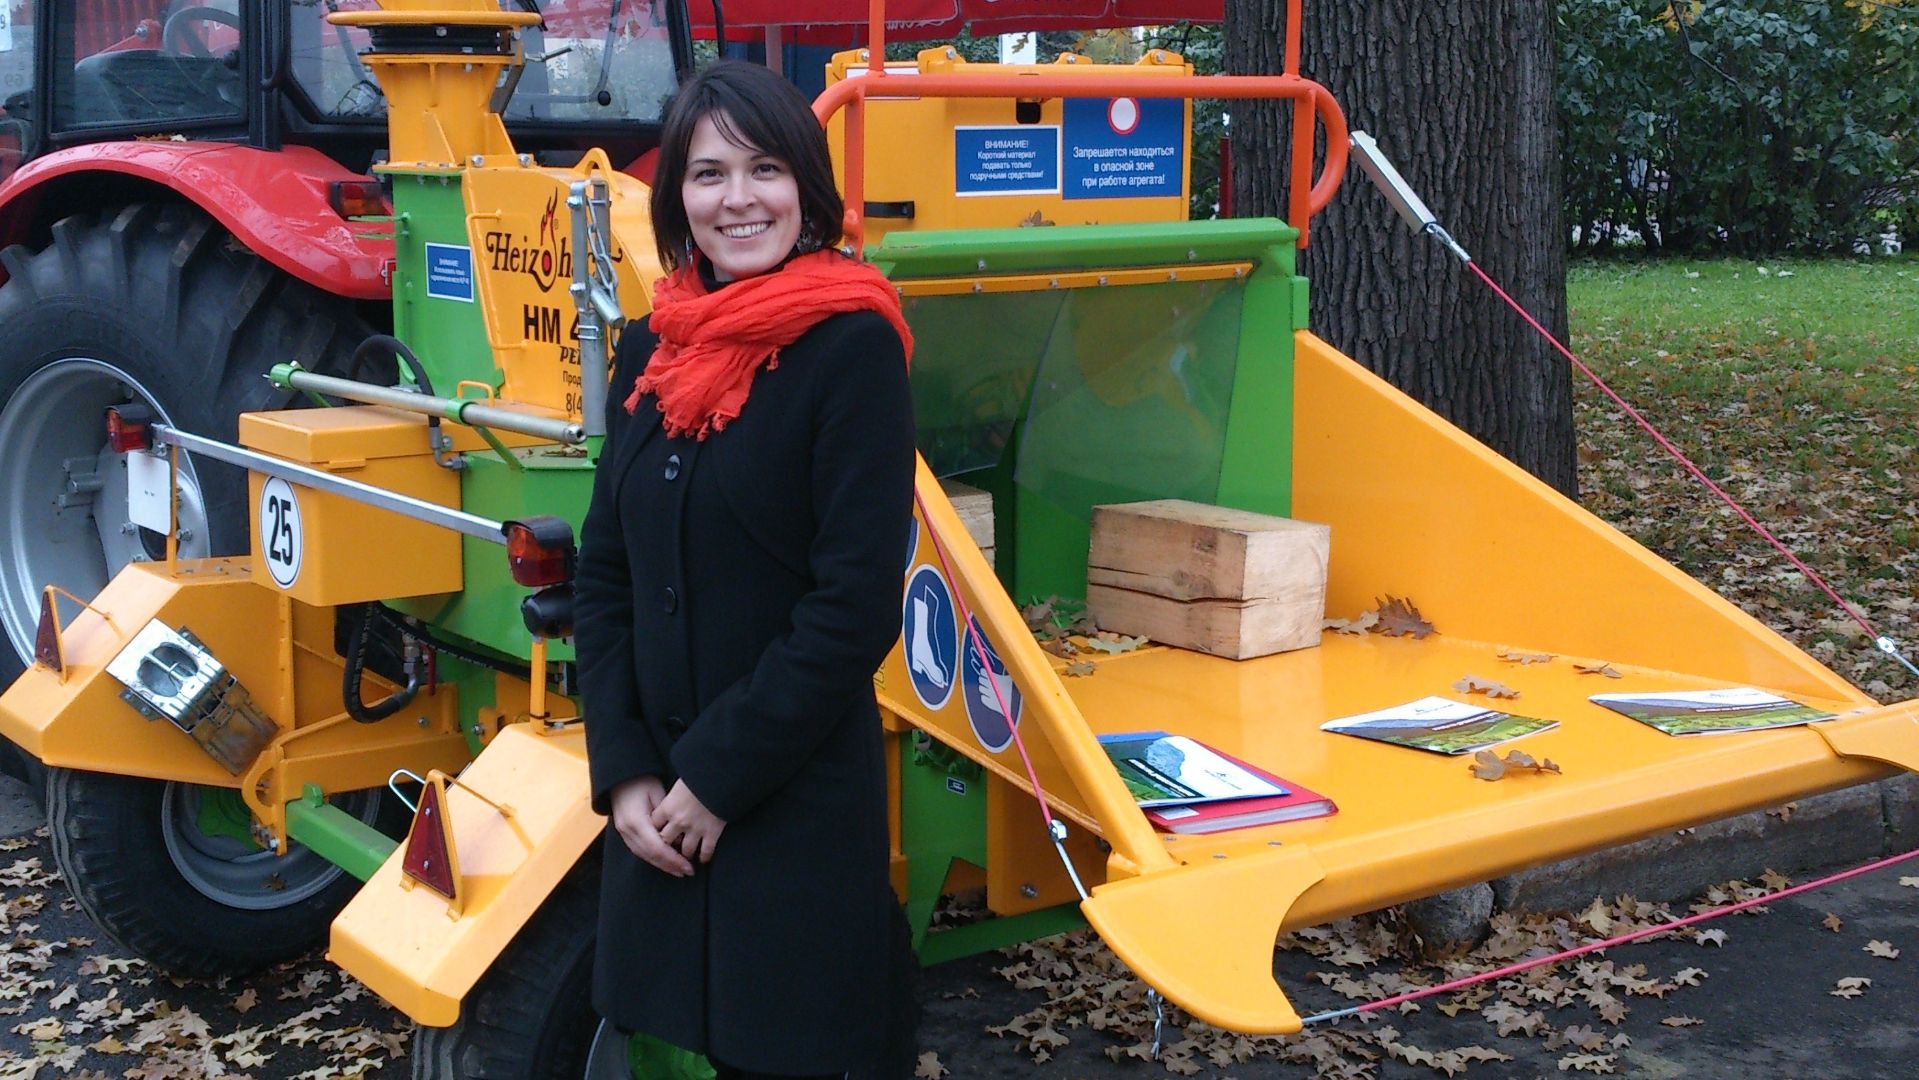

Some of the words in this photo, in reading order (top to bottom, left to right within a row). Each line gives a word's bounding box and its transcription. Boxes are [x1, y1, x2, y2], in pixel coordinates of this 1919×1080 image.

[985, 139, 1029, 149] ВНИМАНИЕ!
[977, 151, 1006, 160] Короткий
[1007, 151, 1036, 159] материал
[1129, 147, 1174, 158] находиться
[1101, 161, 1134, 172] опасной
[1135, 161, 1155, 171] зоне
[1082, 177, 1097, 189] при
[1098, 175, 1127, 188] работе
[1128, 174, 1165, 187] агрегата!
[524, 304, 561, 345] HM
[268, 495, 294, 567] 25
